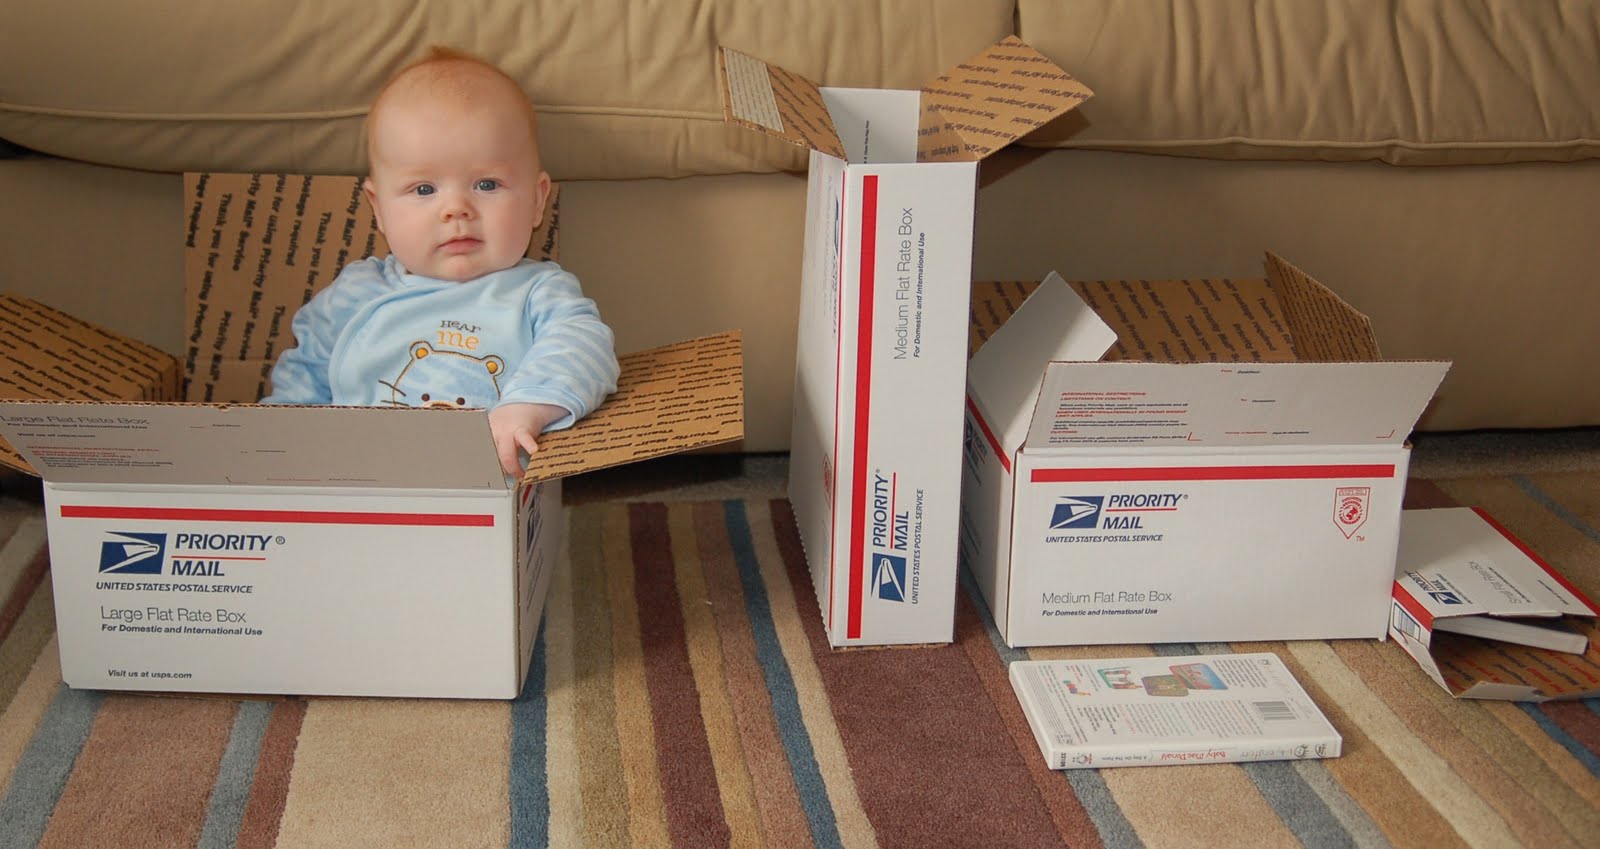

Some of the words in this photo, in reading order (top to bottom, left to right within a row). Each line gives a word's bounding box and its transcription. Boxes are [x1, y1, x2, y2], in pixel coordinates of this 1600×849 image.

[898, 208, 912, 235] Box
[897, 240, 911, 271] Rate
[916, 248, 924, 294] International
[896, 277, 910, 300] Flat
[894, 305, 908, 359] Medium
[914, 302, 922, 342] Domestic
[437, 330, 480, 350] me
[916, 489, 924, 520] SERVICE
[894, 512, 908, 550] MAIL
[1103, 517, 1142, 529] MAIL
[914, 520, 922, 549] POSTAL
[1132, 534, 1163, 542] SERVICE
[172, 560, 224, 576] MAIL
[912, 550, 921, 577] STATES
[96, 582, 134, 590] UNITED
[136, 583, 171, 592] STATES
[172, 584, 210, 592] POSTAL
[211, 585, 252, 593] SERVICE
[1043, 593, 1090, 603] Medium
[1094, 592, 1114, 602] Flat
[1118, 592, 1145, 602] Rate
[1149, 591, 1172, 601] Box
[101, 606, 142, 624] Large
[147, 608, 173, 621] Flat
[178, 608, 212, 622] Rate
[216, 609, 246, 622] Box
[102, 624, 116, 632] For
[118, 624, 162, 633] Domestic
[164, 625, 182, 634] and
[183, 626, 242, 635] International
[244, 628, 262, 636] Use
[108, 669, 126, 678] Visit
[151, 672, 192, 680] usps.com
[1206, 749, 1225, 759] Baby
